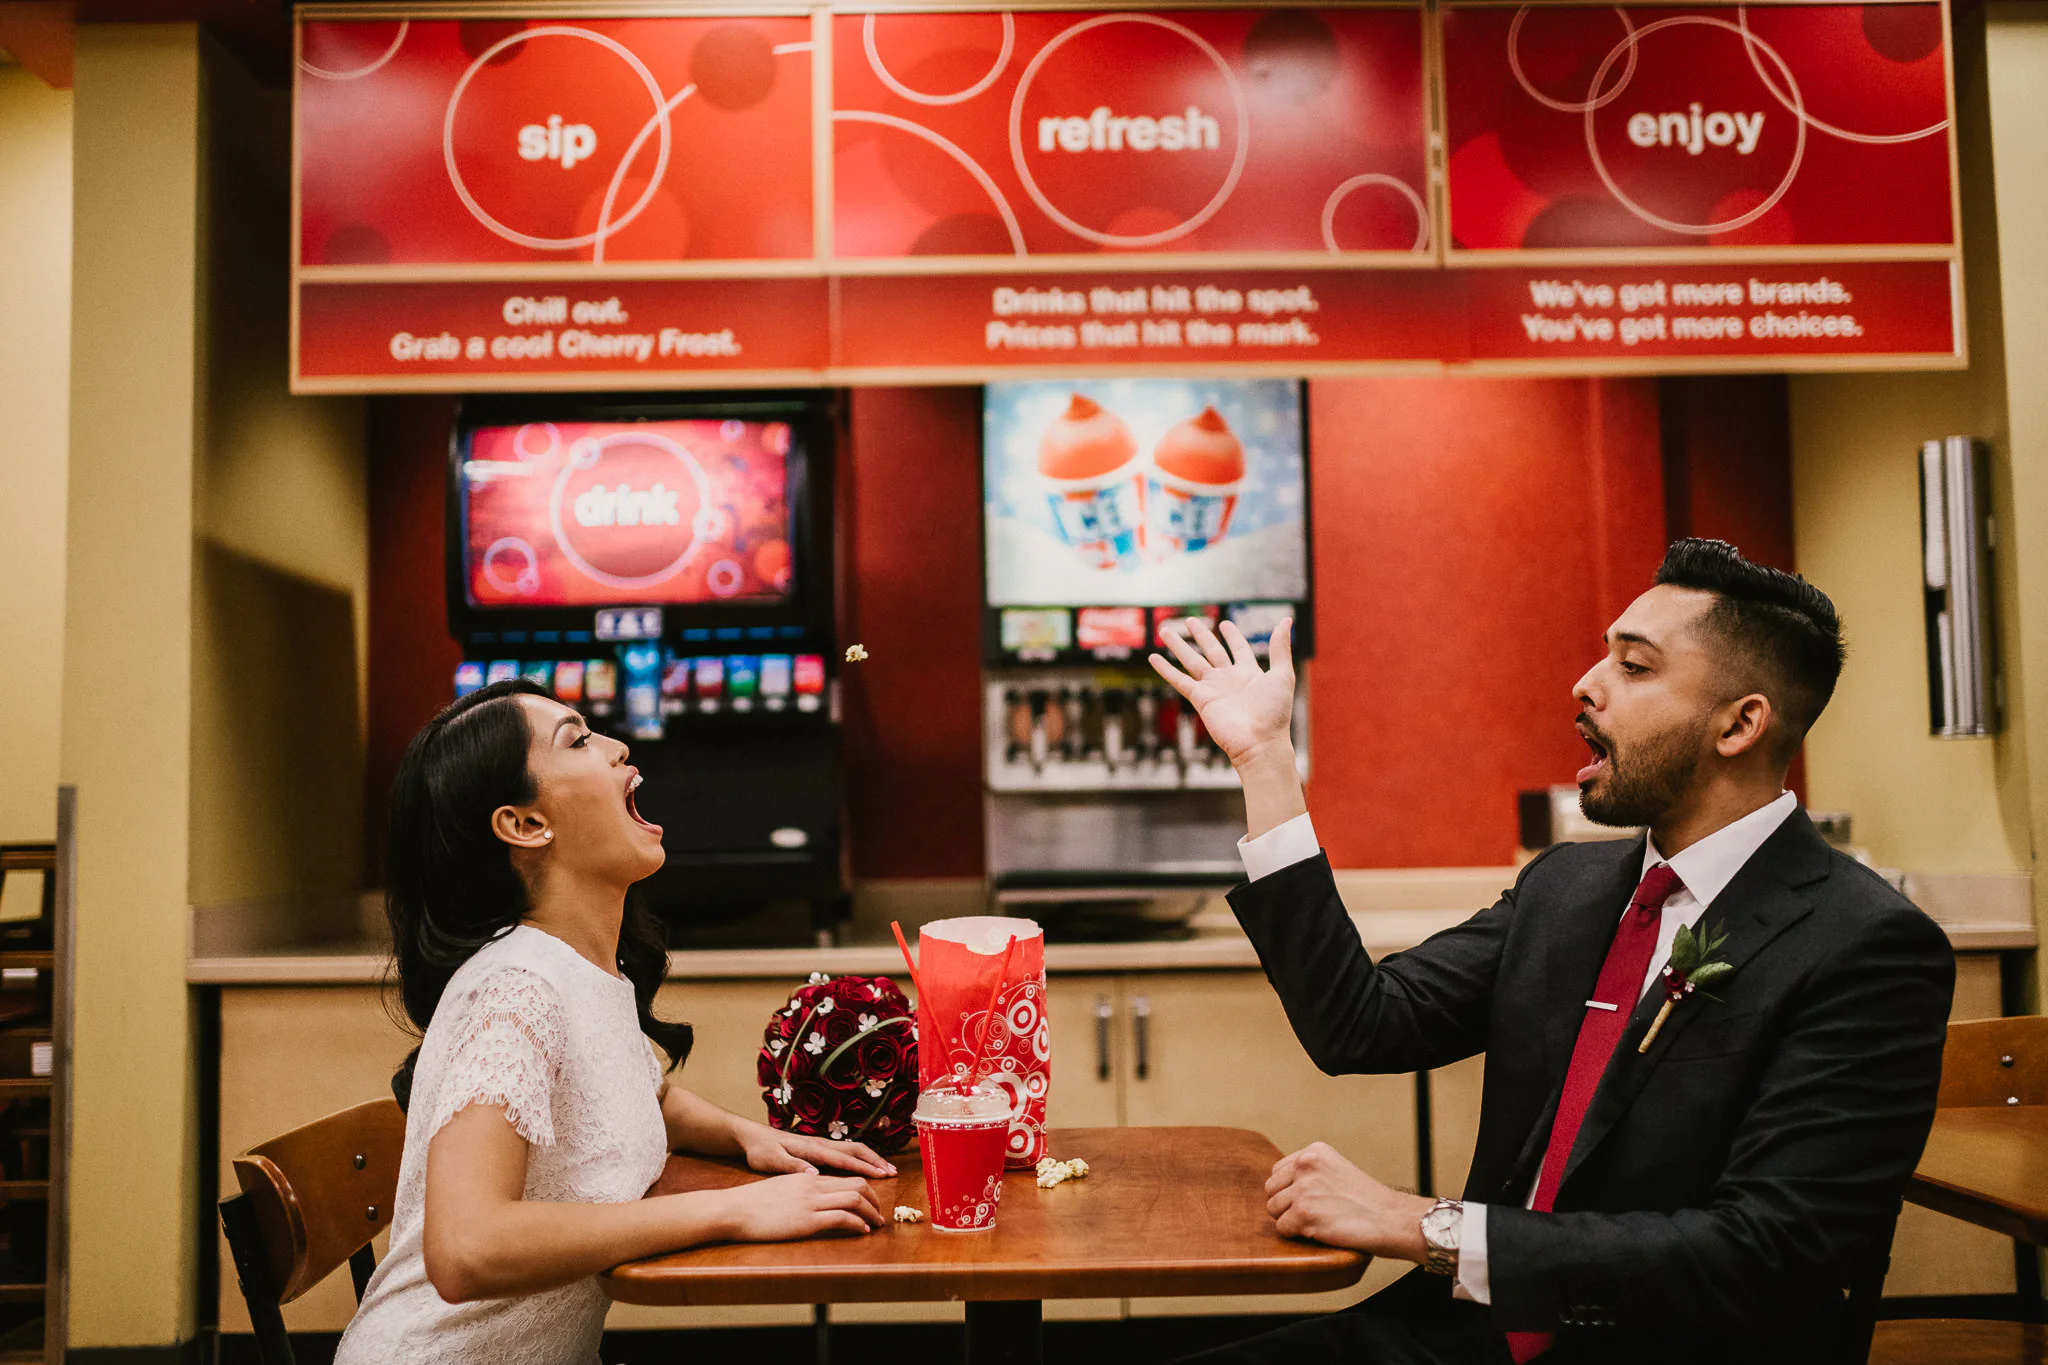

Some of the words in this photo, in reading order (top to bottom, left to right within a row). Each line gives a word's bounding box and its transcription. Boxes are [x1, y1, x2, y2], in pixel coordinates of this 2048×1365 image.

[518, 115, 597, 169] sip
[1038, 106, 1220, 152] refresh
[1628, 103, 1765, 155] enjoy
[503, 297, 567, 326] Chill
[571, 298, 628, 325] out.
[993, 287, 1086, 316] Drinks
[1090, 286, 1148, 313] that
[1152, 285, 1190, 312] hit
[1194, 285, 1243, 312] the
[1247, 285, 1318, 316] spot.
[1530, 280, 1614, 308] We've
[1620, 282, 1666, 312] got
[1672, 283, 1743, 306] more
[1749, 278, 1852, 304] brands.
[390, 332, 460, 361] Grab
[466, 337, 485, 359] a
[491, 331, 555, 359] cool
[558, 327, 656, 362] Cherry
[659, 327, 741, 357] Frost.
[986, 321, 1076, 349] Prices
[1080, 320, 1138, 347] that
[1142, 319, 1181, 346] hit
[1186, 319, 1233, 346] the
[1238, 319, 1318, 346] mark.
[1522, 314, 1613, 342] You've
[1620, 316, 1667, 345] got
[1672, 316, 1743, 339] more
[1749, 312, 1863, 338] choices.
[574, 484, 680, 527] drink
